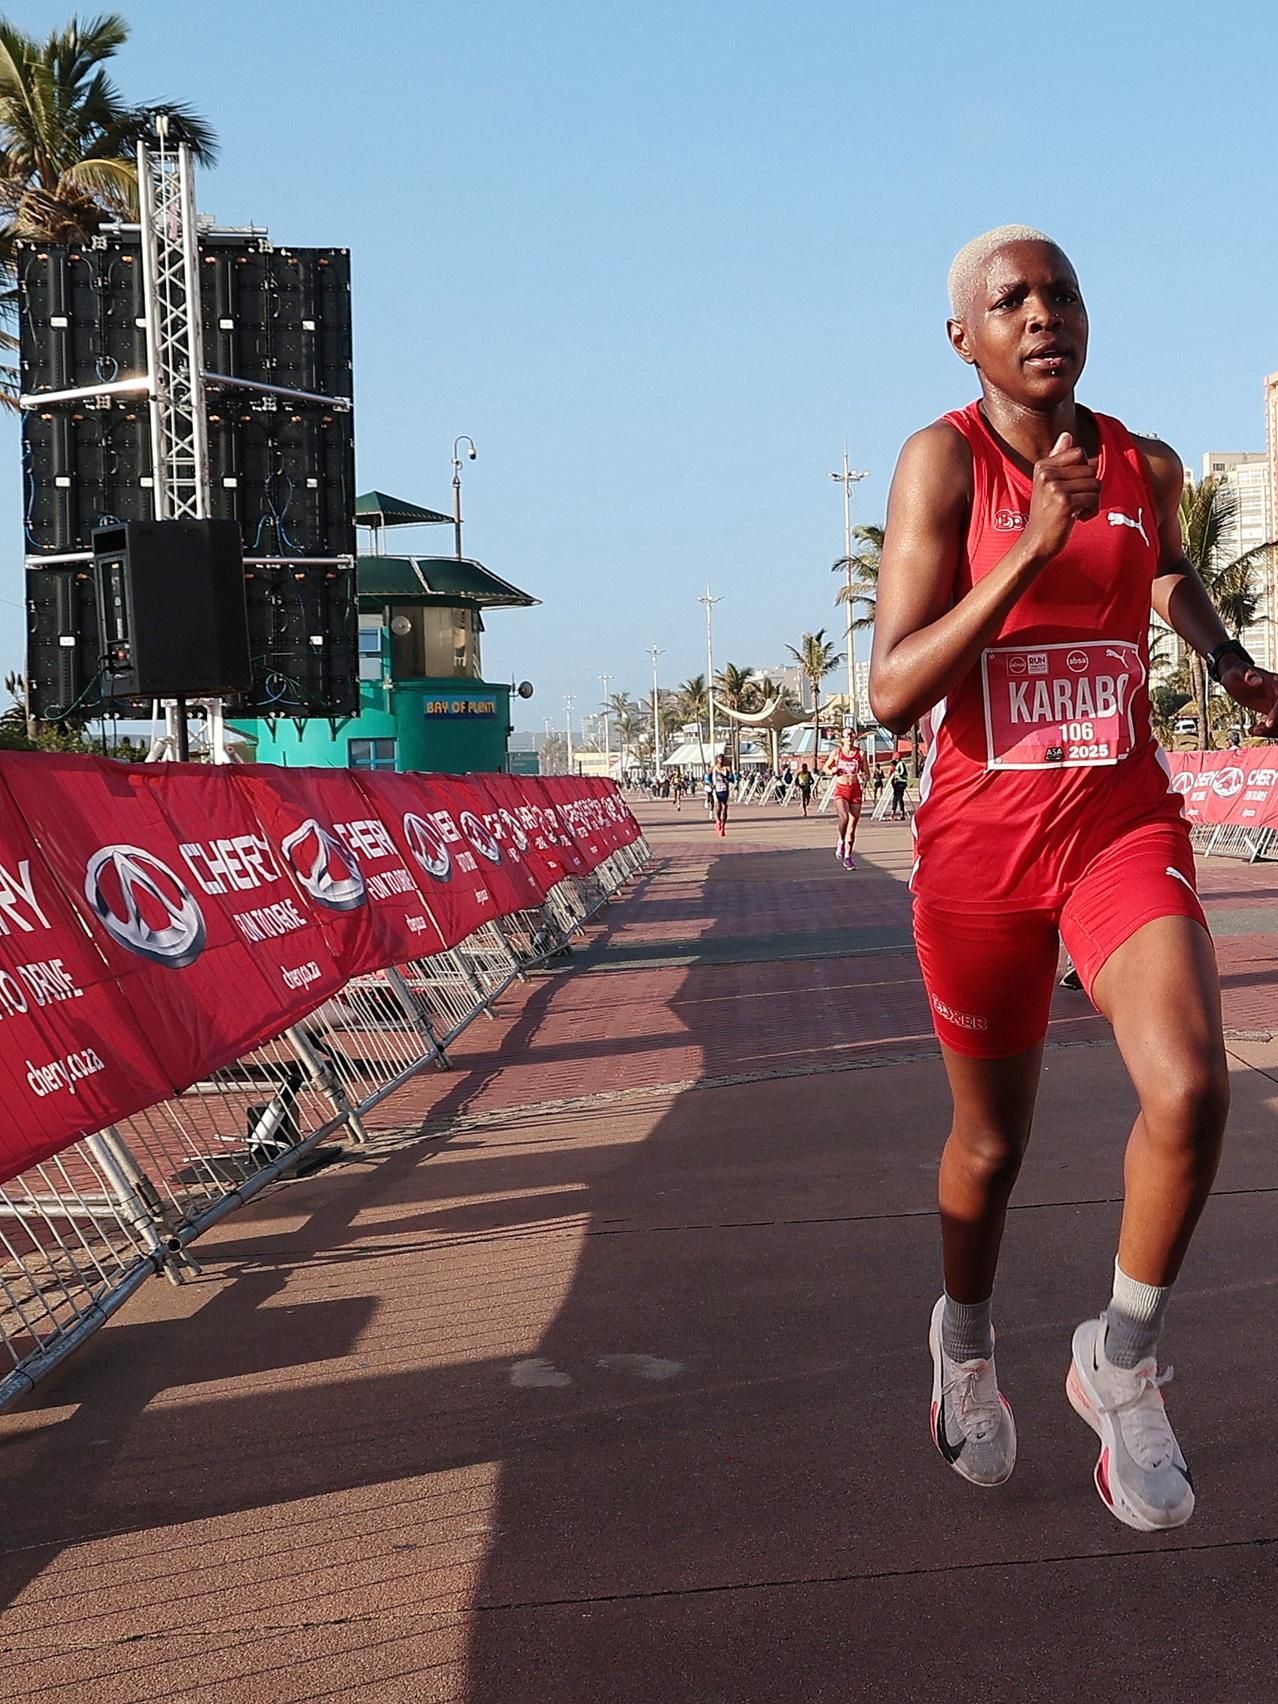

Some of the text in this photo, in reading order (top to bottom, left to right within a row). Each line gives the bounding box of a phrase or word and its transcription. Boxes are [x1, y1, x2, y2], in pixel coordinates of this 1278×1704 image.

[1069, 655, 1086, 664] absa
[427, 701, 448, 713] BAY
[451, 701, 466, 713] OF
[1059, 722, 1093, 742] 106
[1047, 748, 1063, 756] ASA
[1068, 744, 1109, 759] 2025
[178, 834, 282, 895] CHERY
[16, 958, 84, 1007] DRIVE
[25, 1047, 105, 1097] chery.co.za
